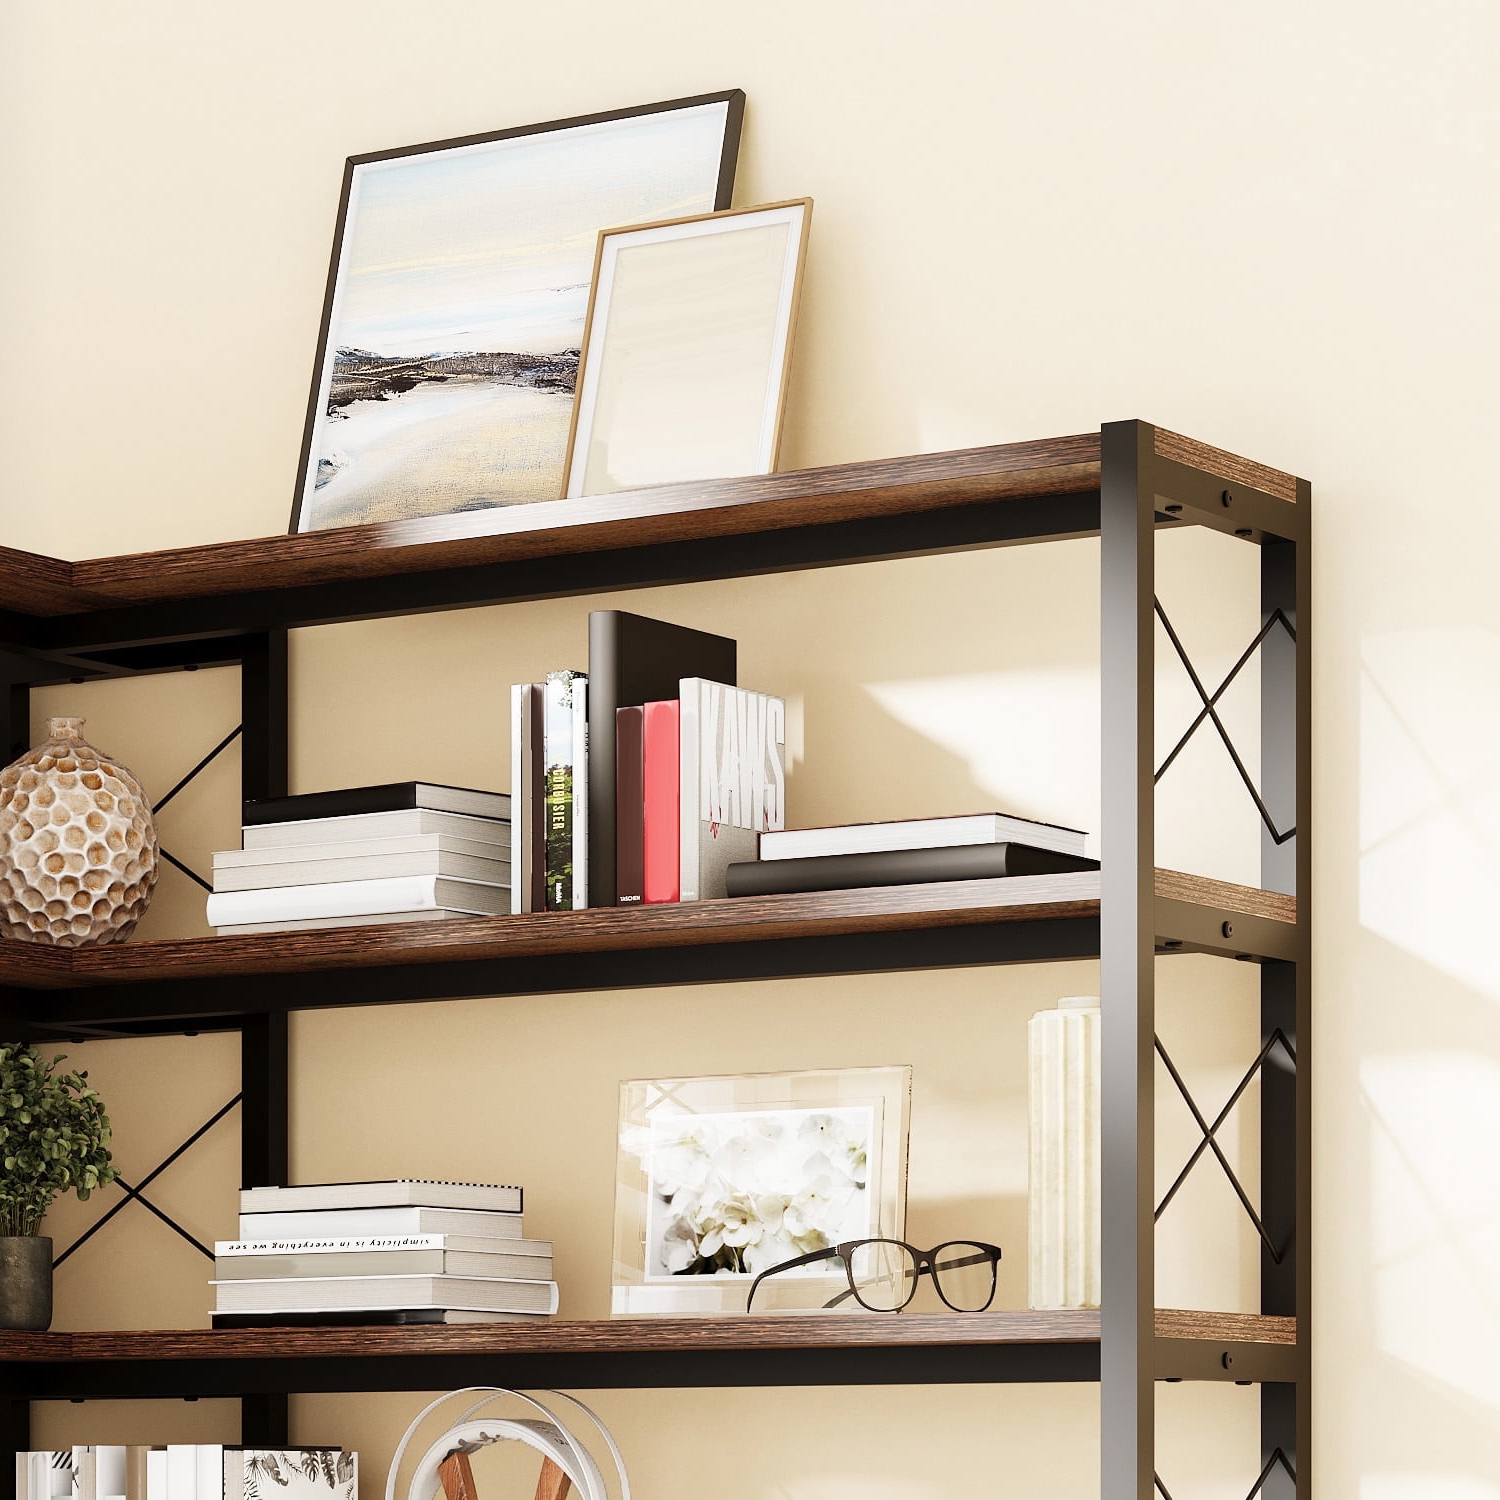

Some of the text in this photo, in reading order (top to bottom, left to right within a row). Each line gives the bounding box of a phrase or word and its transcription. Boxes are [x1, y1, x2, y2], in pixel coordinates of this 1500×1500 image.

[700, 681, 785, 833] KAWS
[553, 768, 565, 830] CORBUSIER
[272, 1242, 335, 1251] everything
[369, 1239, 430, 1248] simplicity
